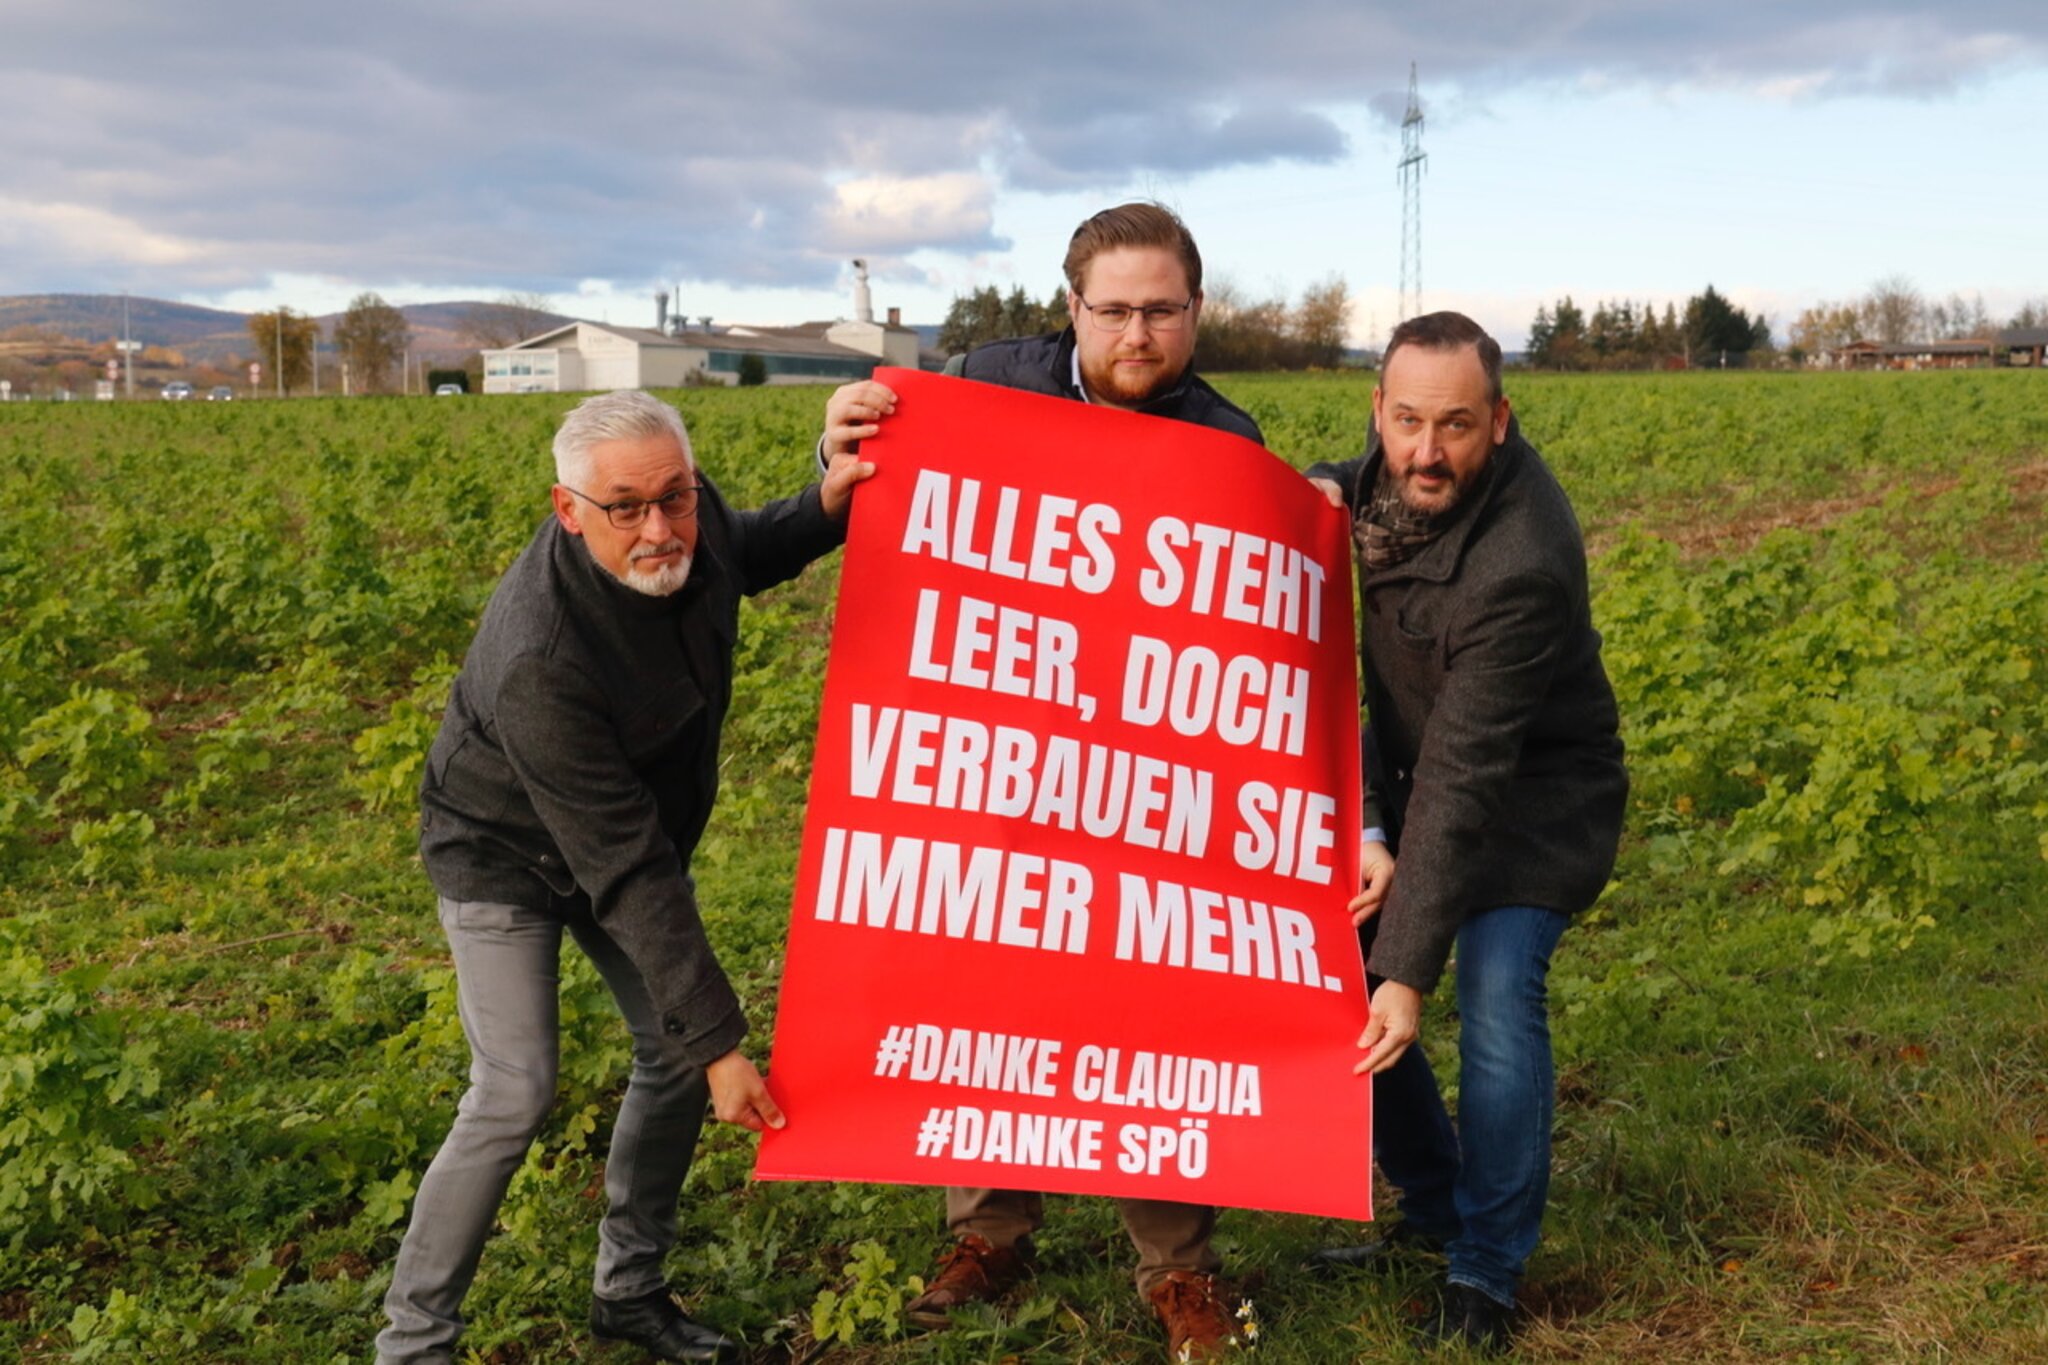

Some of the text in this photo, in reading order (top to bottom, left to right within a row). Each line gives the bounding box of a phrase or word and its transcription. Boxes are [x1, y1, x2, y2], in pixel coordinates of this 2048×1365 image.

[902, 469, 1325, 644] ALLES STEHT
[908, 589, 1309, 757] LEER, DOCH
[850, 703, 1335, 885] VERBAUEN SIE
[815, 827, 1342, 992] IMMER MEHR.
[875, 1024, 1262, 1117] #DANKE CLAUDIA
[916, 1106, 1208, 1179] #DANKE SPÖ
